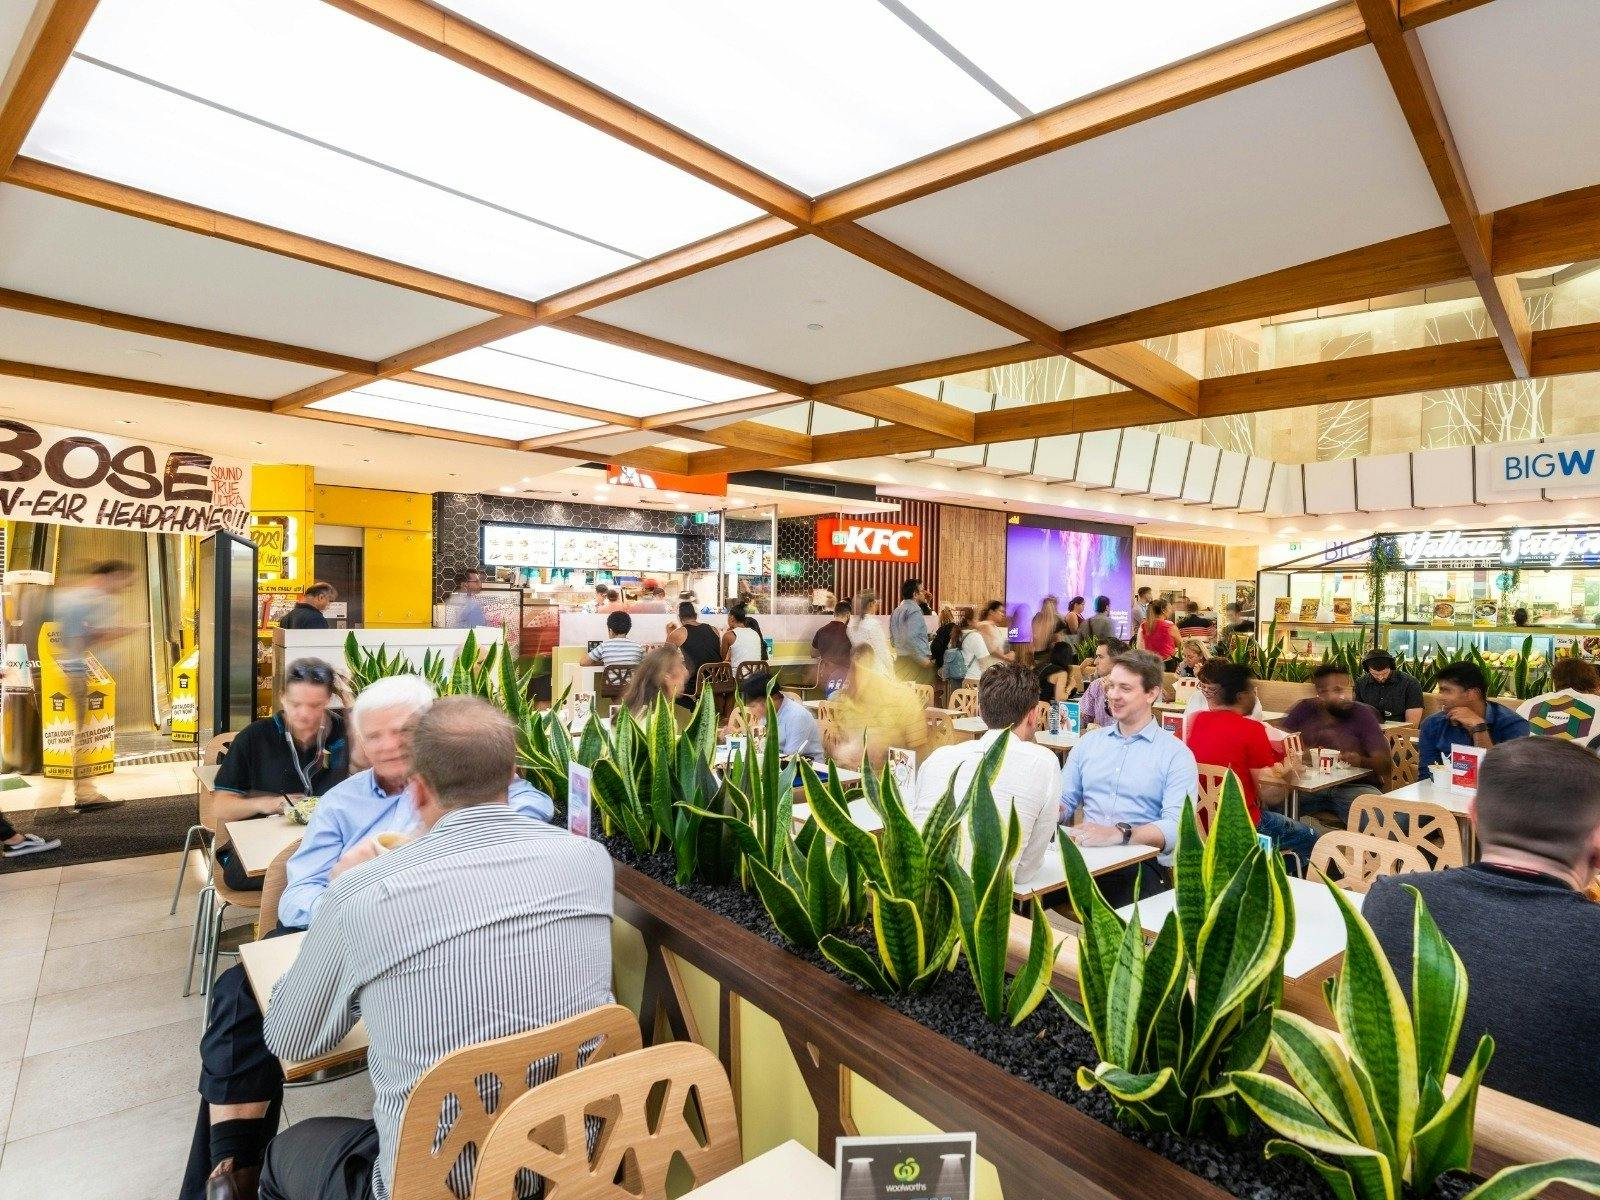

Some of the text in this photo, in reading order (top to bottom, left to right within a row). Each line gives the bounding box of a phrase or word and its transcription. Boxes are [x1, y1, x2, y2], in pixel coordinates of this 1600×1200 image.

[0, 419, 213, 503] BOSE
[210, 465, 243, 481] SOUND
[211, 479, 240, 496] TRUE
[0, 487, 87, 524] N-EAR
[213, 493, 245, 509] ULTRA
[844, 526, 914, 557] KFC
[44, 729, 75, 738] CATALOGUE
